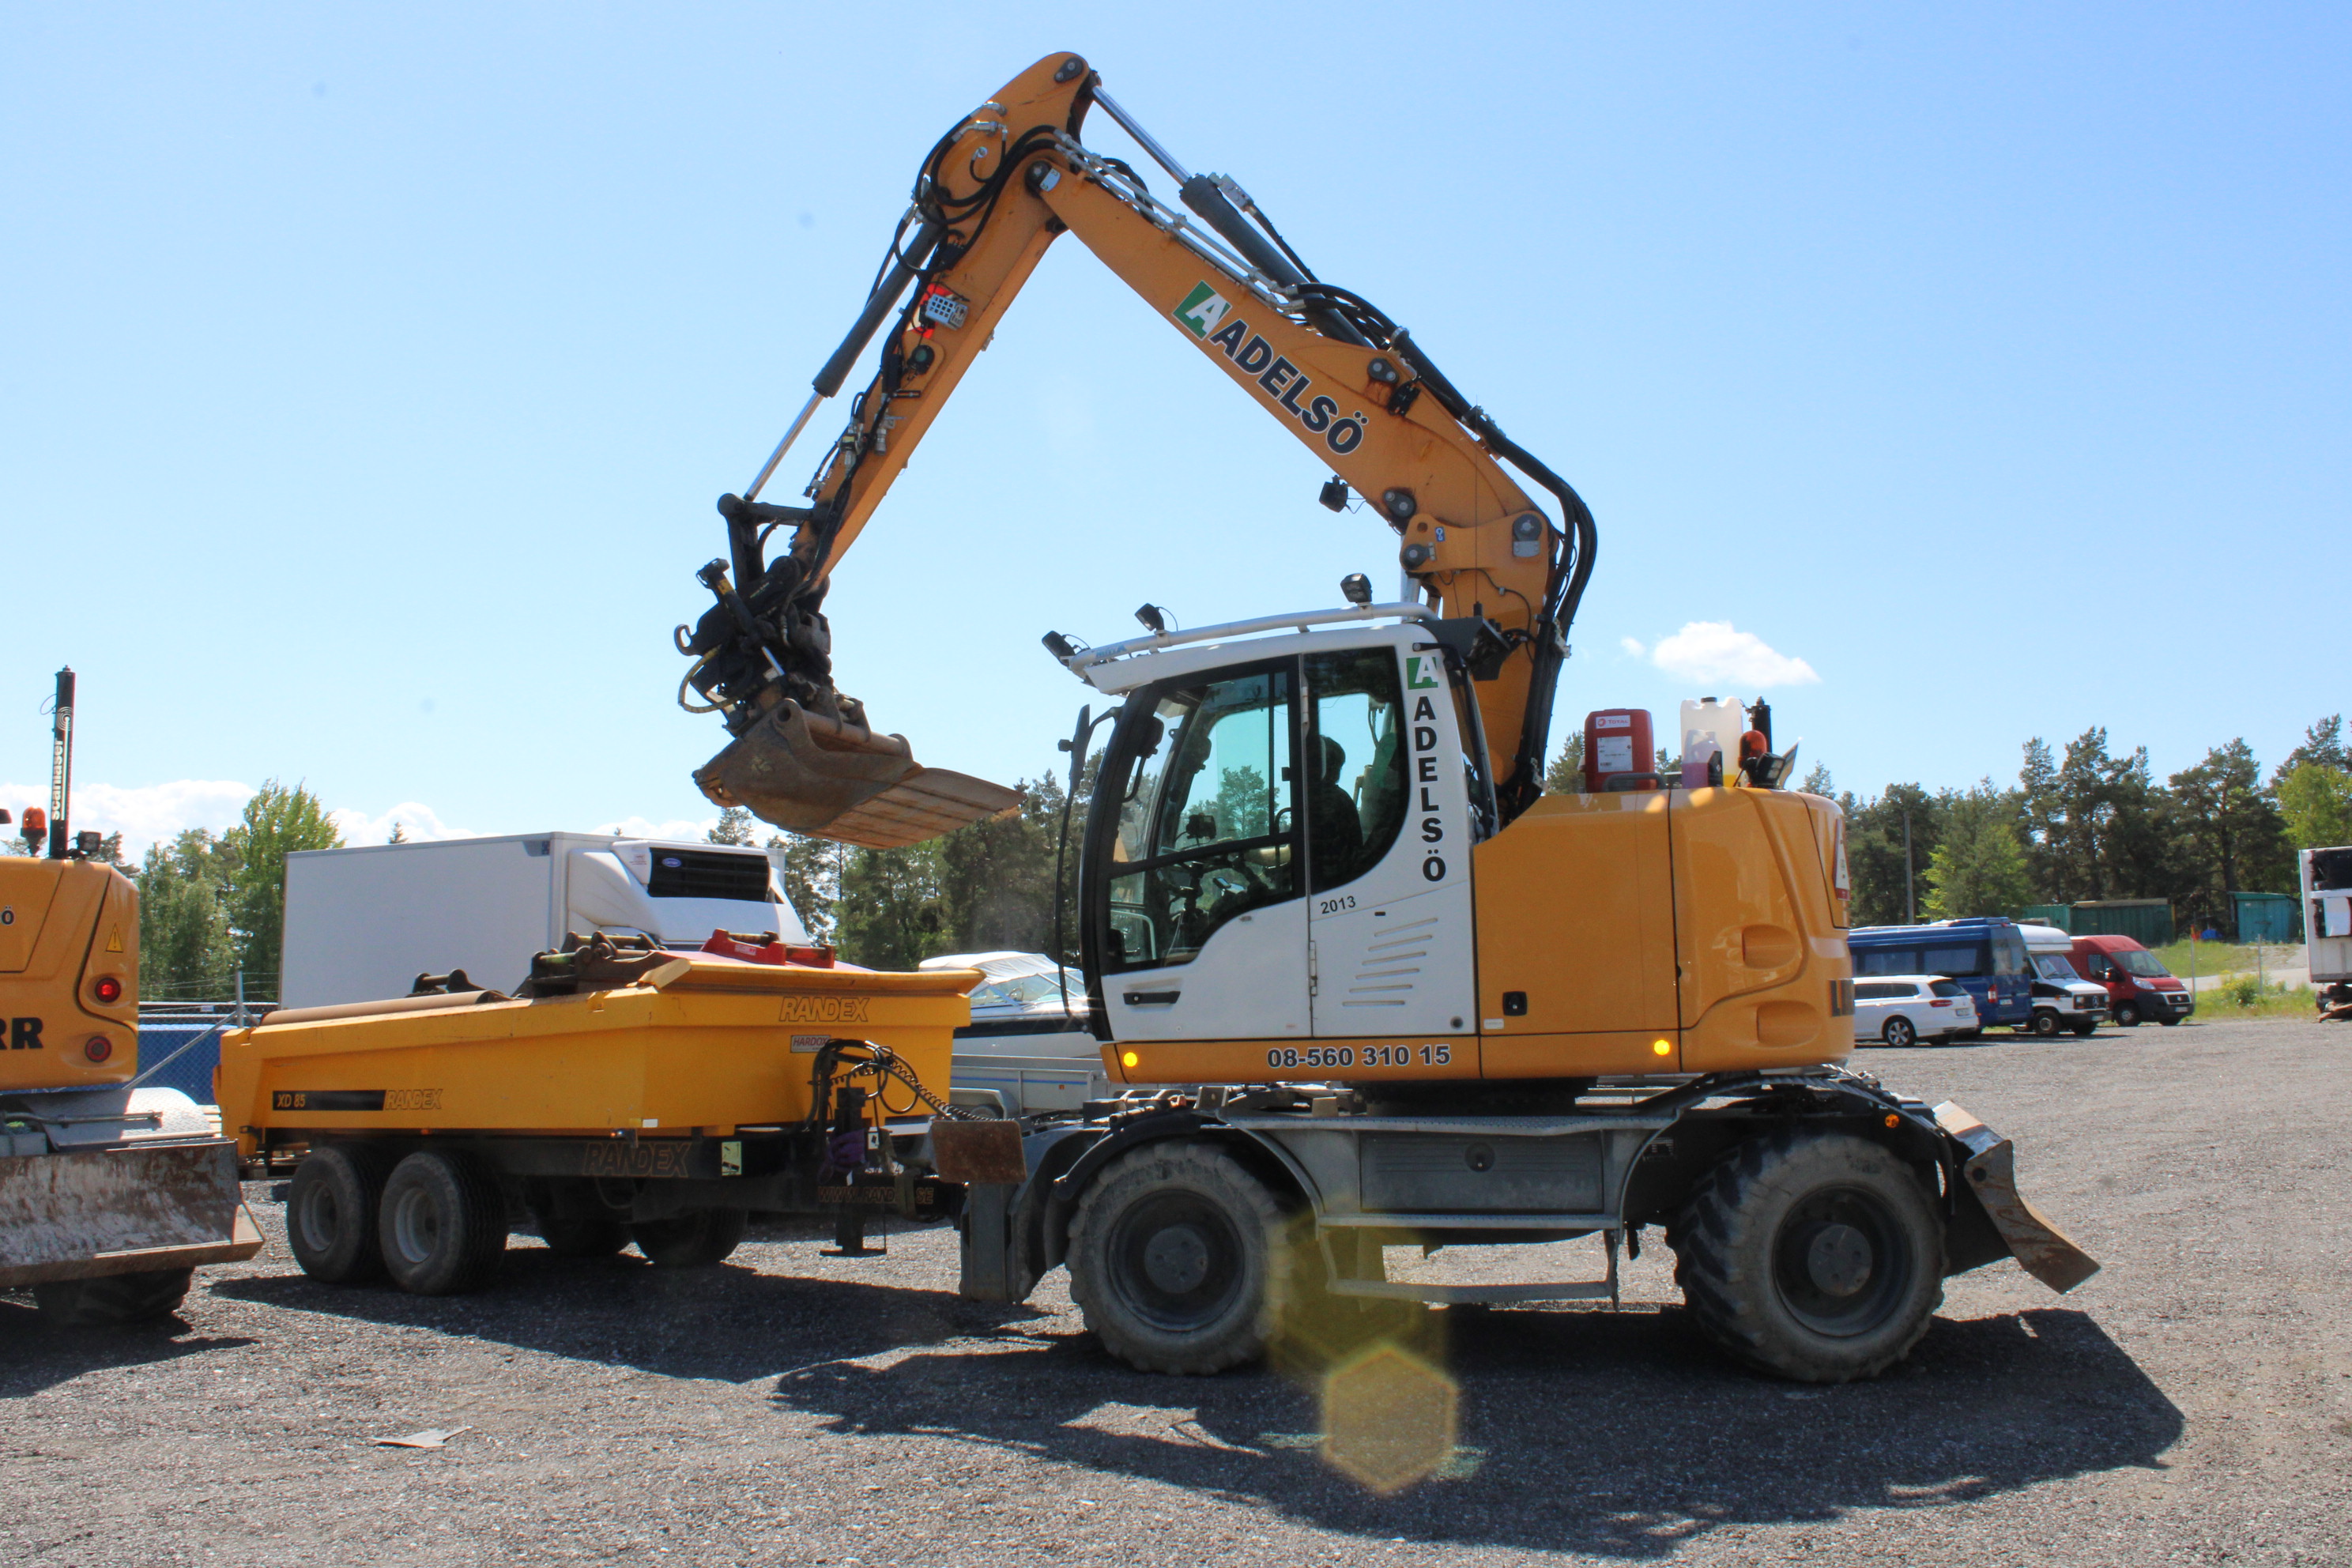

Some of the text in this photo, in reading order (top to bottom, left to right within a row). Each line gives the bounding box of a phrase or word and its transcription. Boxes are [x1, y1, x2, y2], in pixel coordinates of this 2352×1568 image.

[1208, 318, 1369, 455] ADELSÖ
[51, 737, 64, 821] scanlaser
[1414, 695, 1446, 882] ADELSÖ
[1321, 895, 1356, 914] 2013
[778, 997, 870, 1023] RANDEX
[1267, 1044, 1451, 1069] 08-560 310 15
[277, 1094, 307, 1108] XD 85
[385, 1089, 443, 1110] RANDEX
[582, 1141, 692, 1178] RANDEX
